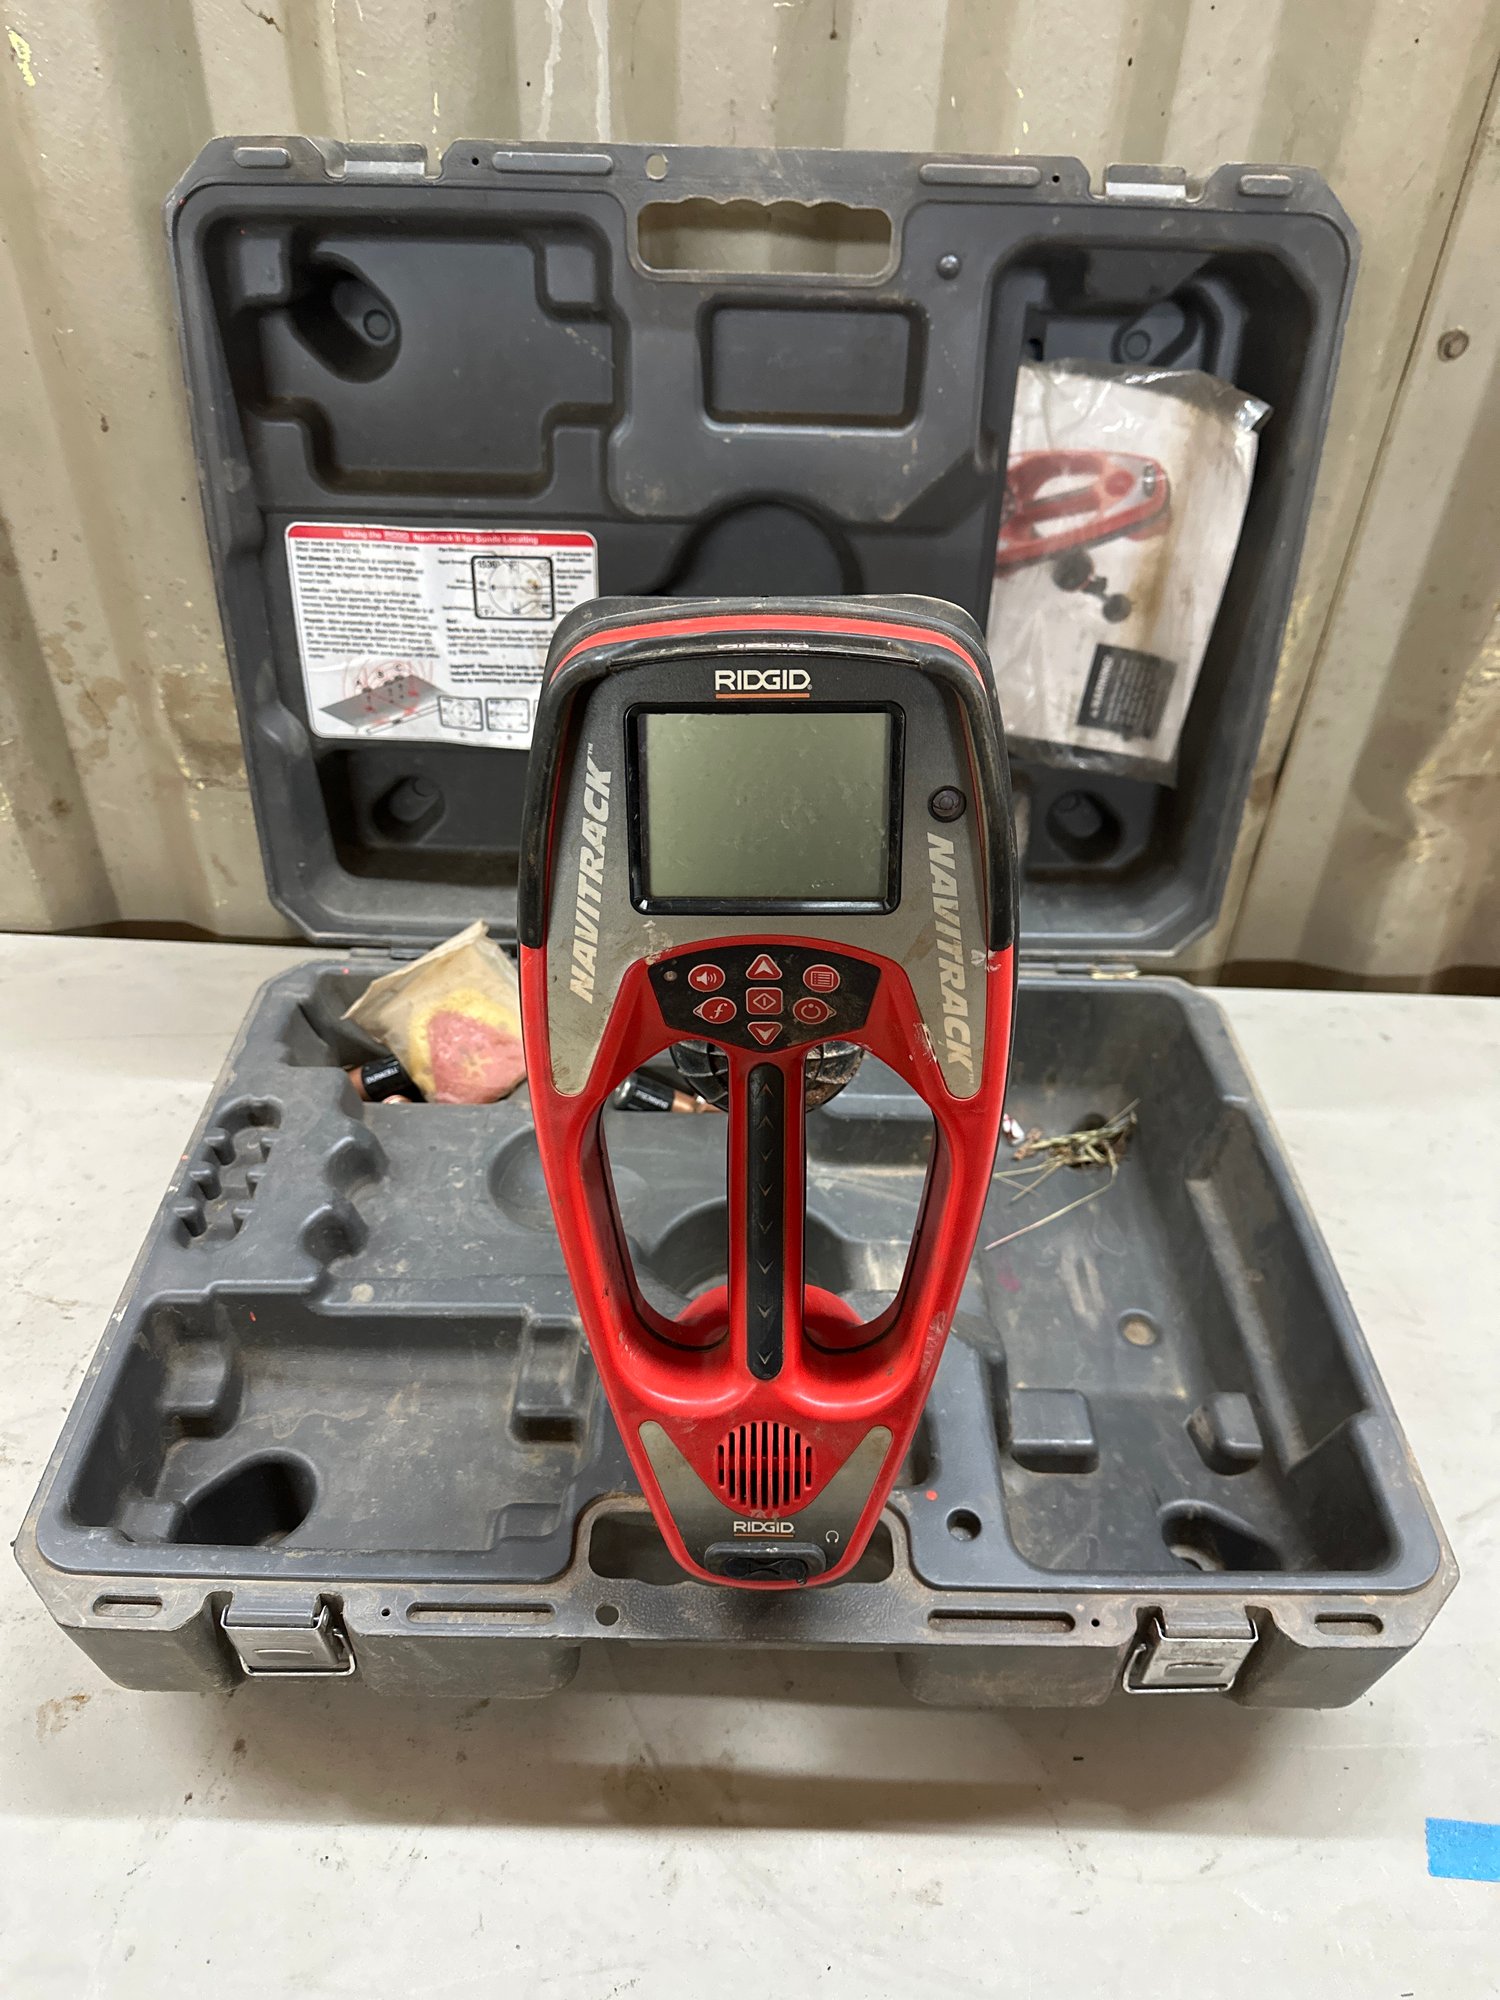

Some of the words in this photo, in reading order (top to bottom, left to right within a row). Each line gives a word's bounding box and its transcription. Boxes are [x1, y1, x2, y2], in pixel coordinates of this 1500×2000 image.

[714, 669, 811, 691] RIDGID
[569, 754, 612, 1005] NAVITRACK
[926, 831, 973, 1075] NAVITRACK
[733, 1520, 795, 1534] RIDGID
